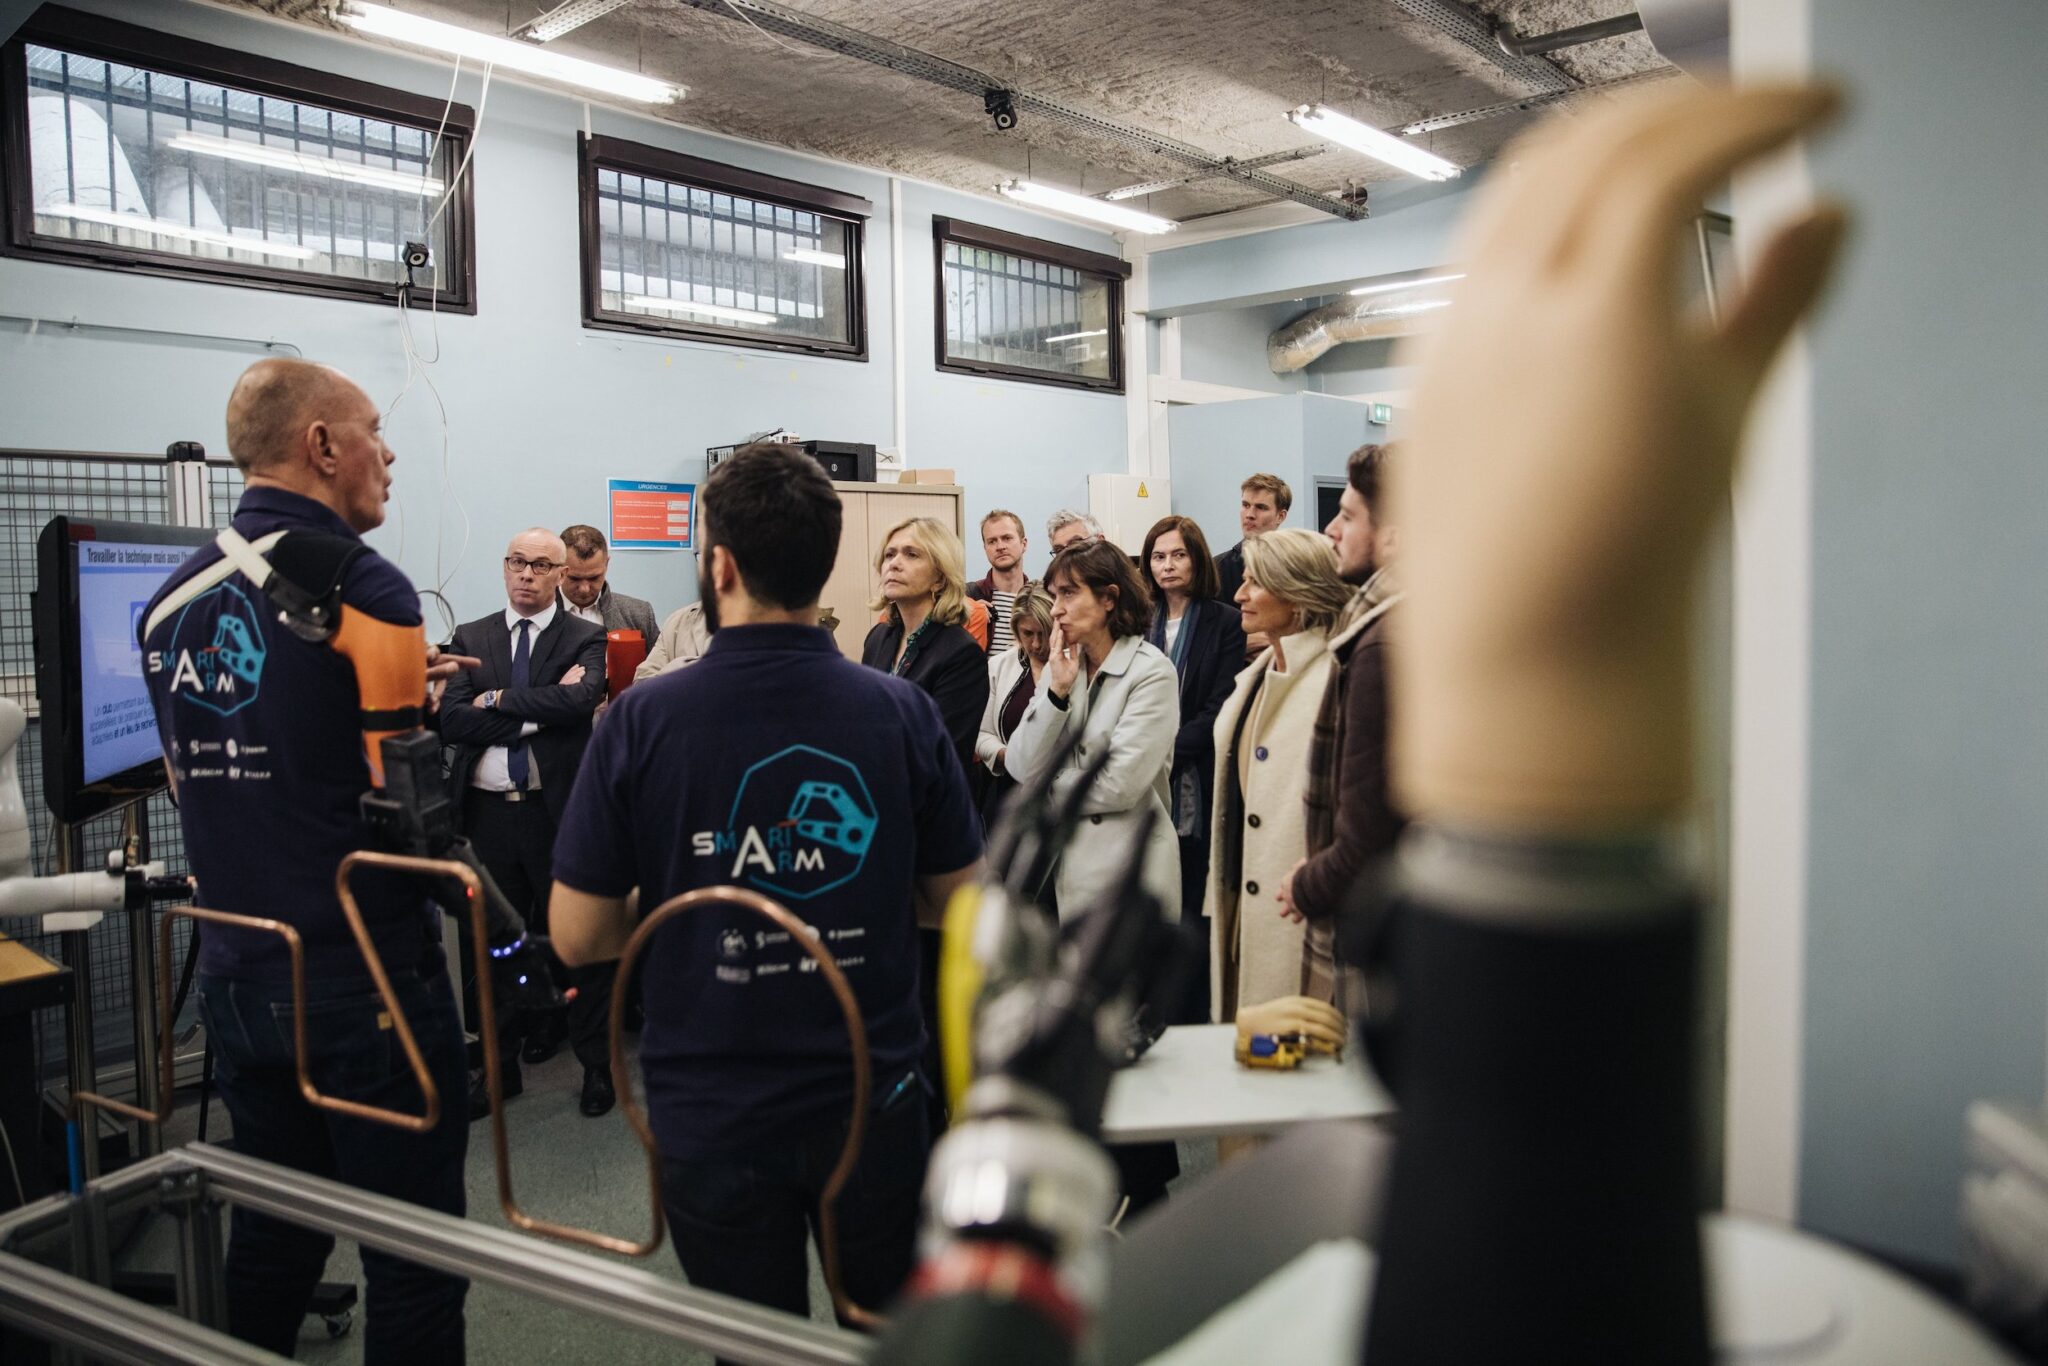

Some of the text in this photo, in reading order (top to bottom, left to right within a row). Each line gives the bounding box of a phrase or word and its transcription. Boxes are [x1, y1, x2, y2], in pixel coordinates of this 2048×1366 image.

[638, 483, 668, 491] URGENCES
[87, 547, 117, 563] Travailler
[118, 549, 123, 562] la
[125, 549, 152, 566] technique
[153, 551, 166, 564] mais
